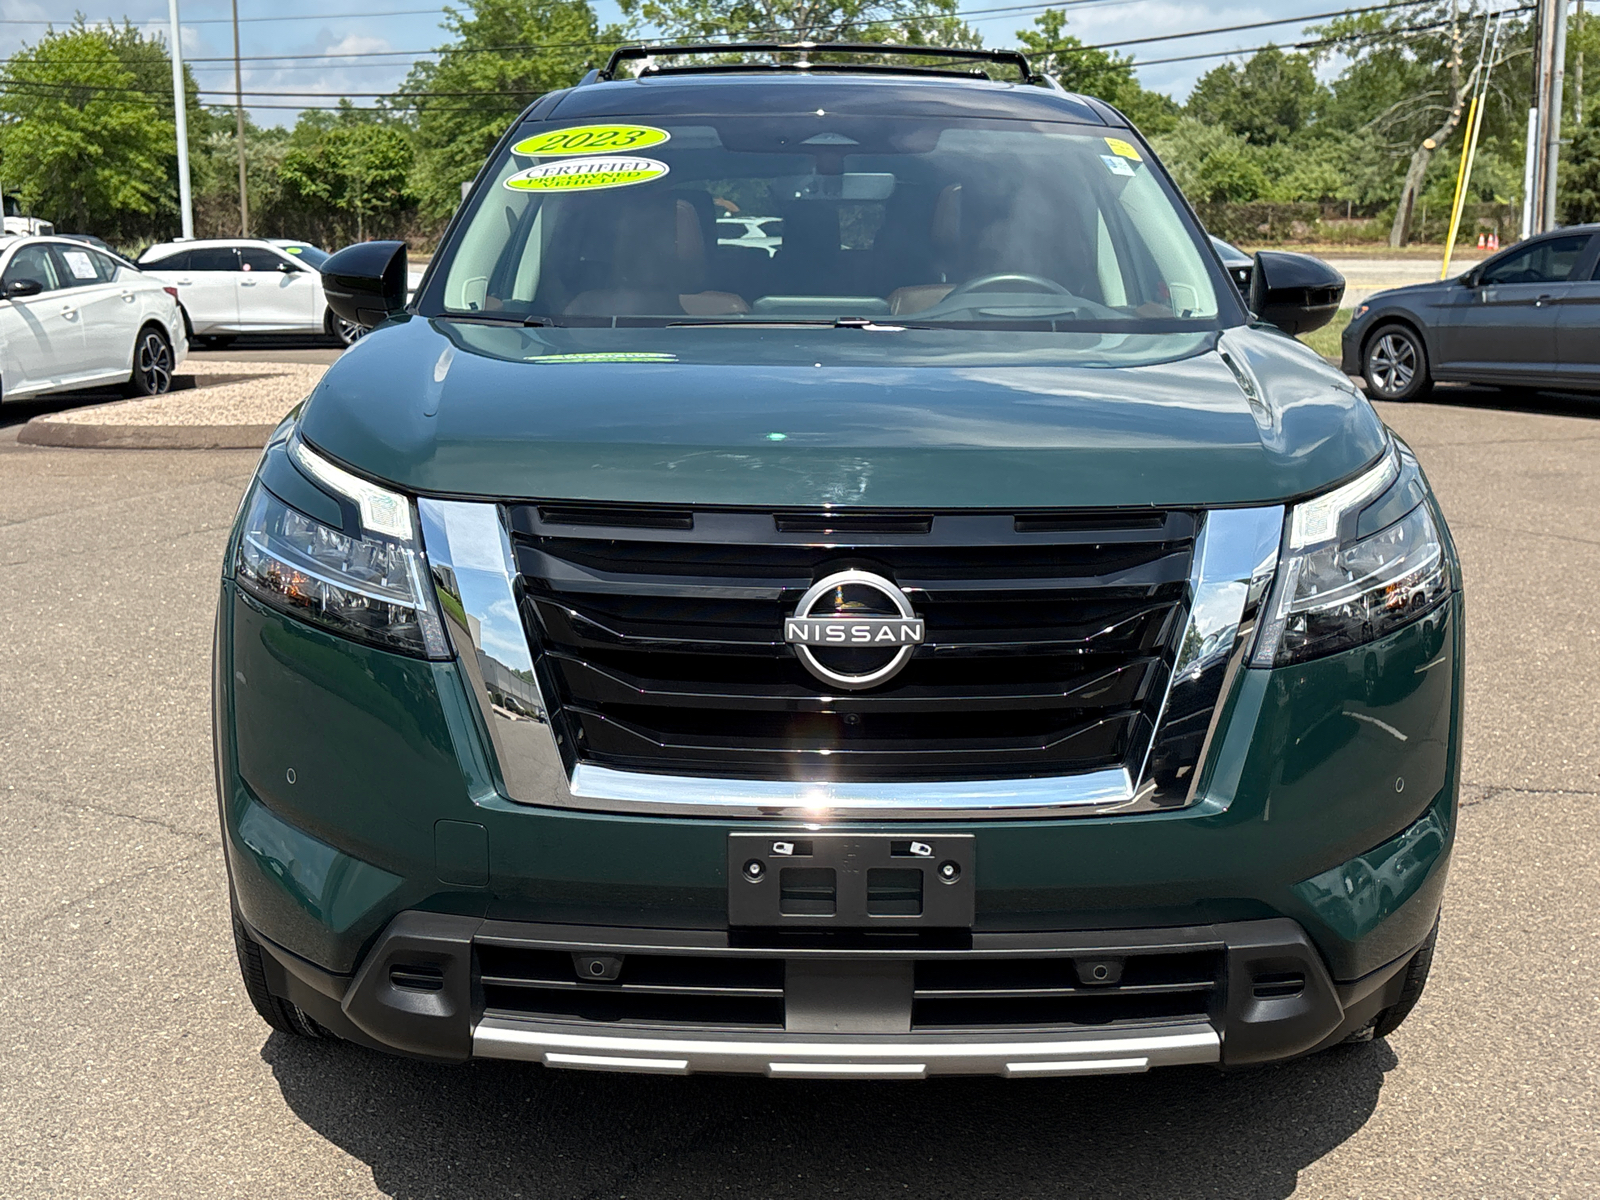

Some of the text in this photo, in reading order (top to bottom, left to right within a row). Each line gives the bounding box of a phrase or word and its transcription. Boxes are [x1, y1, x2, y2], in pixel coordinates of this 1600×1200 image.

[533, 130, 647, 152] 2023
[526, 162, 651, 178] CERTIFIED
[527, 172, 641, 185] PRE-OWNED
[543, 178, 622, 188] VEHICLE
[788, 623, 921, 642] NISSAN
